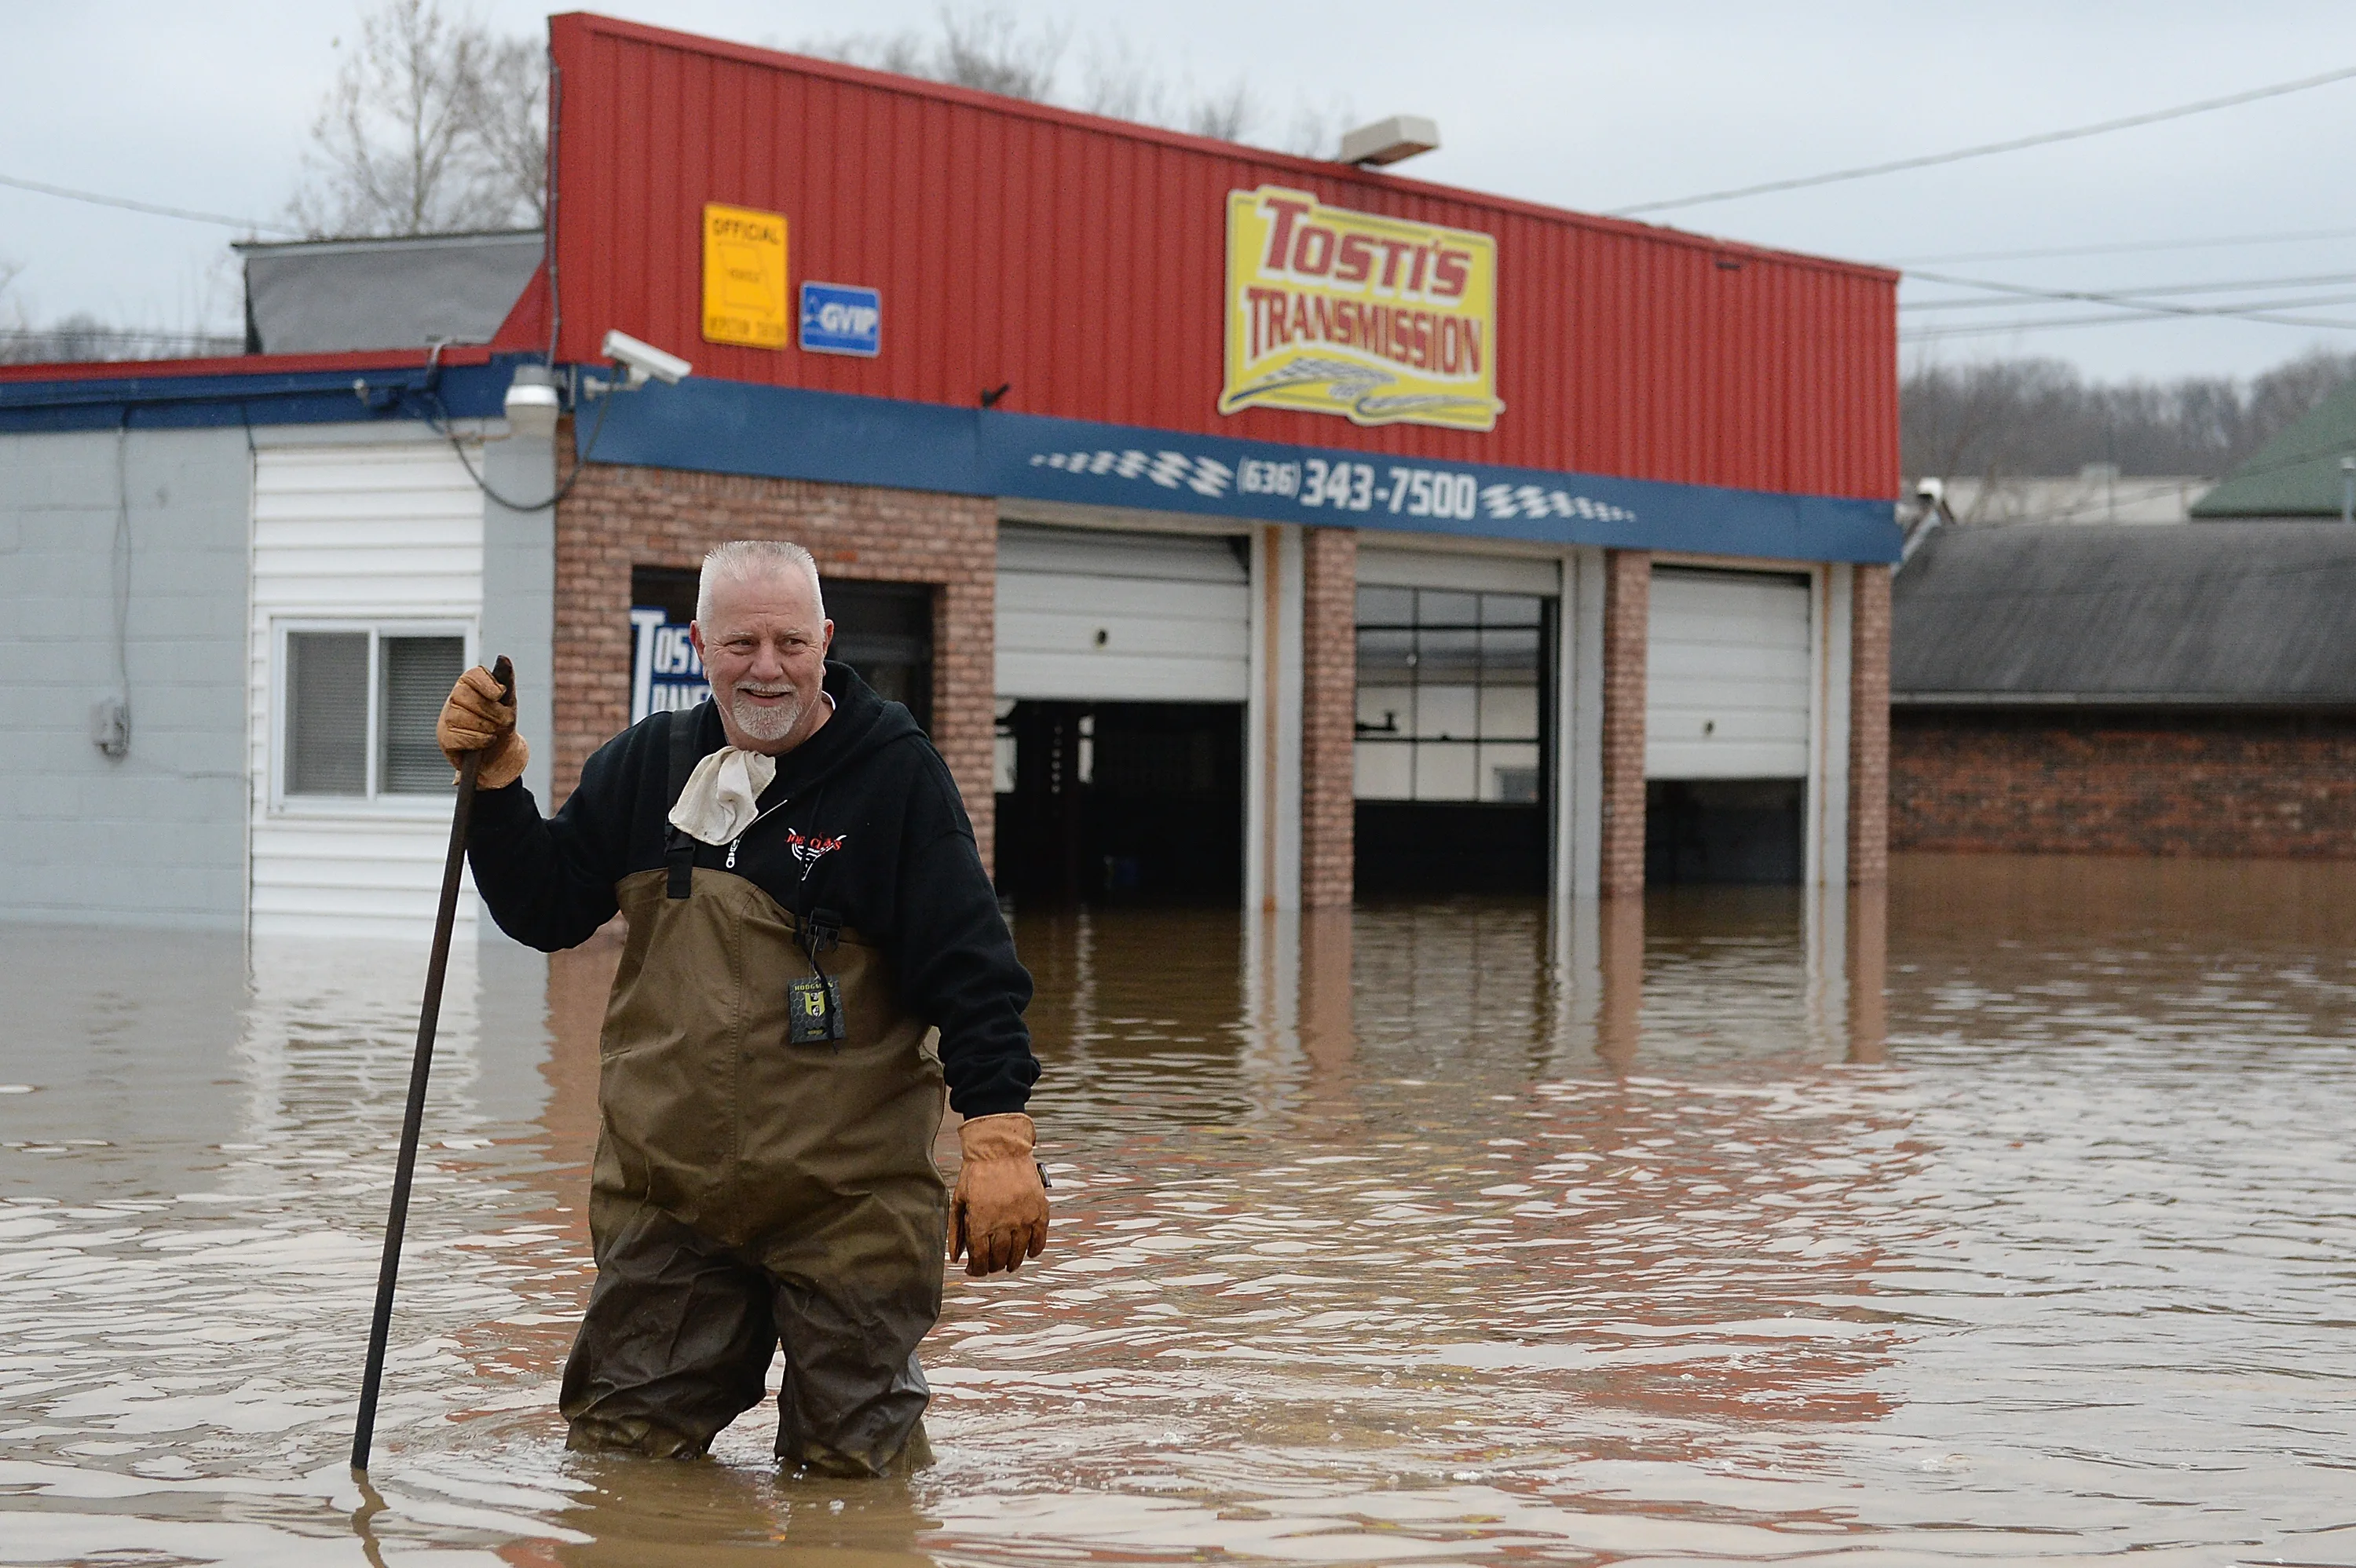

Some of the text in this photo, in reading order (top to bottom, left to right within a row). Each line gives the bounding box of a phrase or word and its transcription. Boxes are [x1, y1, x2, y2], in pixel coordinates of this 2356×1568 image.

[1264, 197, 1472, 297] TOSTI'S
[1246, 285, 1483, 375] TRANSMISSION
[1237, 455, 1479, 521] (636) 343-7500
[795, 981, 833, 991] HODGMN
